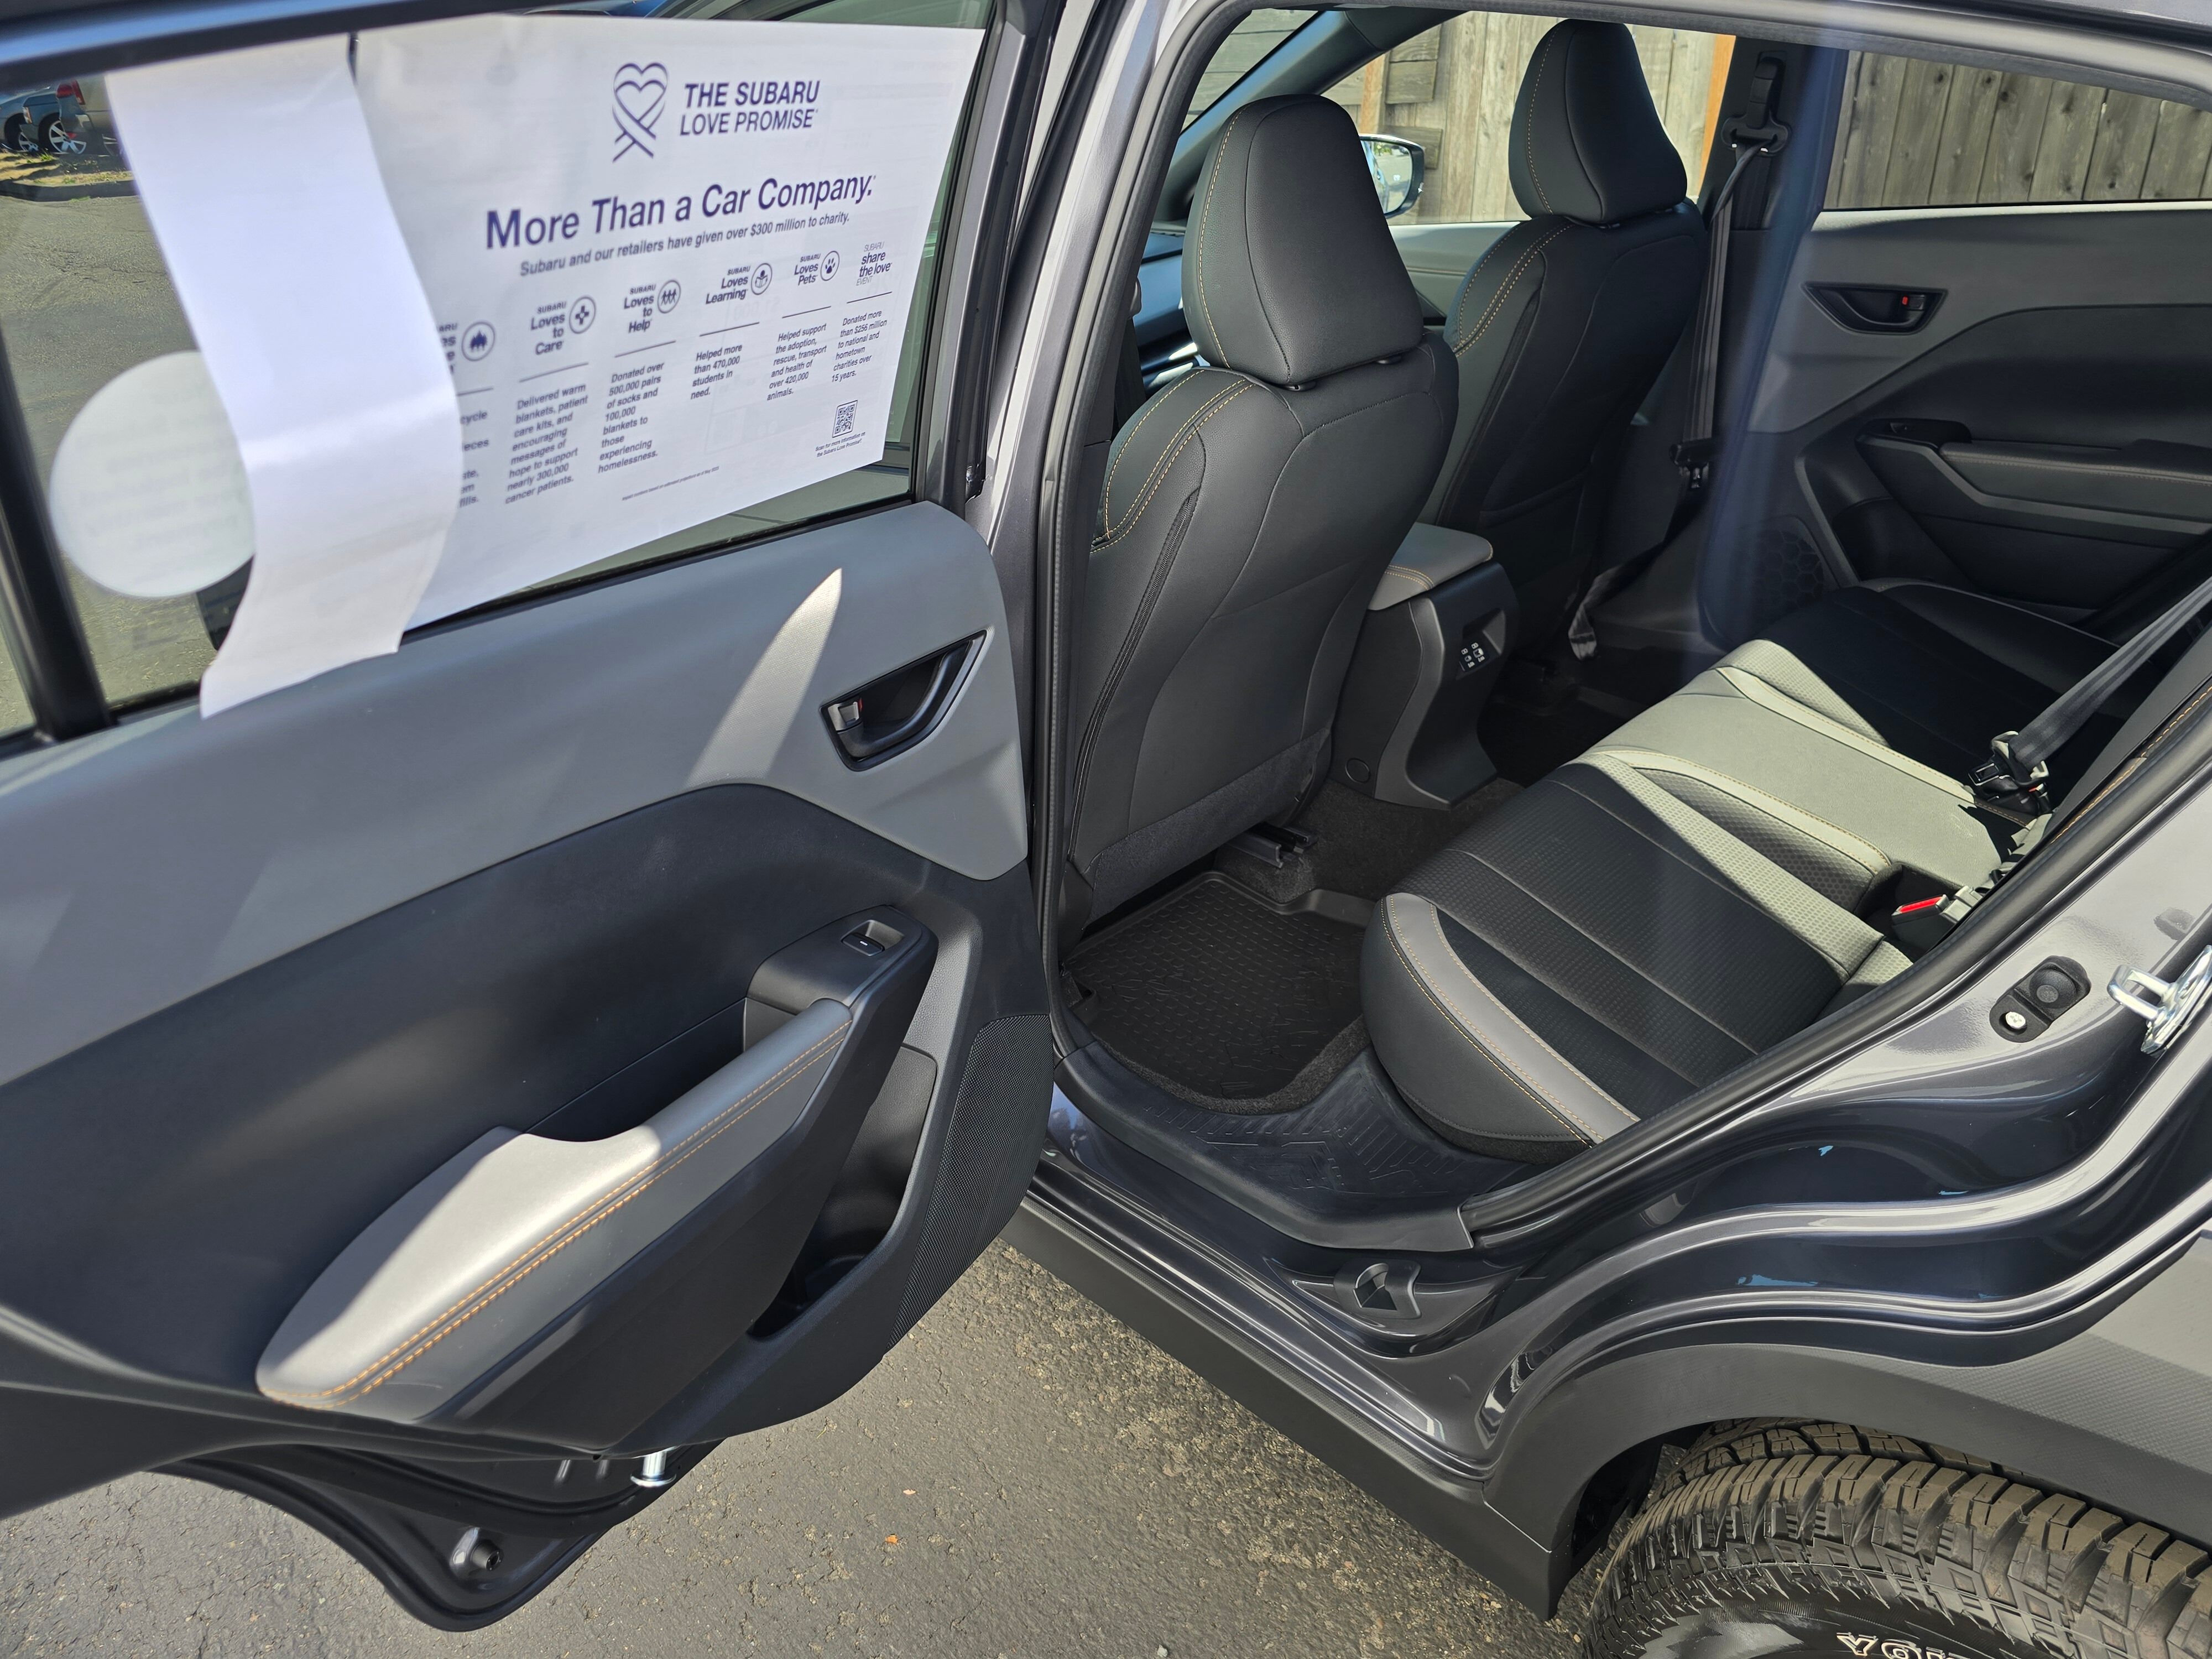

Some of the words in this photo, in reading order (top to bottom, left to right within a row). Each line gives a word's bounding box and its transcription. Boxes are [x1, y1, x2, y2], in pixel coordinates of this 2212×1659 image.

[685, 82, 729, 108] THE
[734, 80, 821, 106] SUBARU
[680, 112, 731, 137] LOVE
[734, 108, 816, 133] PROMISE
[486, 208, 580, 250] More
[592, 196, 665, 234] Than
[675, 196, 692, 222] a
[702, 184, 751, 217] Car
[758, 175, 873, 211] Company.
[520, 257, 566, 276] Subaru
[569, 251, 591, 267] and
[594, 248, 614, 262] our
[617, 239, 664, 257] retailers
[667, 236, 692, 250] have
[695, 231, 723, 248] given
[726, 227, 748, 240] over
[750, 222, 773, 237] $300
[775, 218, 806, 233] million
[808, 217, 817, 227] to
[819, 211, 849, 226] charity.
[864, 241, 885, 252] SUBARU
[800, 253, 821, 263] SUBARU
[861, 252, 886, 265] share
[727, 265, 751, 275] SUBARU
[794, 262, 818, 275] Loves
[859, 265, 873, 278] the
[874, 263, 891, 275] love
[721, 276, 748, 289] Loves
[798, 274, 816, 286] Pets
[856, 276, 873, 286] EVENT
[630, 284, 656, 295] SUBARU
[706, 289, 747, 304] Learning
[538, 301, 567, 314] SUBARU
[623, 295, 654, 310] Loves
[643, 307, 653, 317] to
[843, 314, 867, 326] Donated
[868, 310, 882, 320] more
[531, 314, 565, 331] Loves
[628, 319, 651, 333] Help
[840, 327, 853, 337] than
[854, 324, 868, 335] $256
[869, 319, 887, 331] million
[553, 327, 564, 338] to
[778, 330, 801, 342] Helped
[802, 323, 827, 337] support
[838, 341, 844, 349] to
[845, 335, 868, 347] national
[869, 331, 880, 341] and
[535, 341, 563, 355] Care
[696, 348, 722, 361] Helped
[724, 345, 743, 356] more
[776, 344, 786, 354] the
[787, 337, 817, 352] adoption,
[836, 346, 865, 361] hometown
[774, 353, 797, 366] rescue,
[798, 345, 827, 361] transport
[833, 358, 858, 371] charities
[859, 354, 872, 364] over
[611, 366, 645, 383] Donated
[646, 362, 665, 373] over
[694, 364, 711, 374] than
[713, 356, 740, 369] 470,000
[771, 367, 784, 378] and
[785, 362, 805, 374] health
[806, 359, 813, 368] of
[692, 372, 724, 387] students
[726, 369, 733, 378] in
[769, 380, 784, 389] over
[785, 371, 809, 384] 420,000
[832, 374, 838, 383] 15
[839, 370, 857, 382] years.
[609, 380, 639, 397] 500,000
[641, 375, 661, 389] pairs
[691, 387, 711, 400] need.
[767, 388, 794, 401] animals.
[517, 389, 560, 410] Delivered
[562, 383, 587, 397] warm
[607, 400, 615, 409] of
[617, 393, 640, 406] socks
[643, 388, 658, 399] and
[460, 410, 488, 425] cycle
[515, 406, 555, 424] blankets,
[558, 395, 588, 414] patient
[605, 406, 636, 422] 100,000
[514, 426, 534, 438] care
[536, 420, 554, 431] kits,
[557, 412, 573, 425] and
[603, 419, 637, 435] blankets
[640, 416, 648, 425] to
[463, 440, 489, 451] eces
[512, 428, 567, 451] encouraging
[601, 435, 624, 448] those
[511, 444, 555, 465] messages
[557, 439, 567, 449] of
[599, 440, 653, 461] experiencing
[509, 466, 531, 479] hope
[534, 461, 542, 469] to
[544, 448, 578, 466] support
[598, 450, 658, 473] homelessness.
[507, 476, 535, 491] nearly
[536, 463, 569, 481] 300,000
[505, 488, 535, 504] cancer
[537, 475, 573, 494] patients.
[1836, 1632, 1971, 1659] YO
